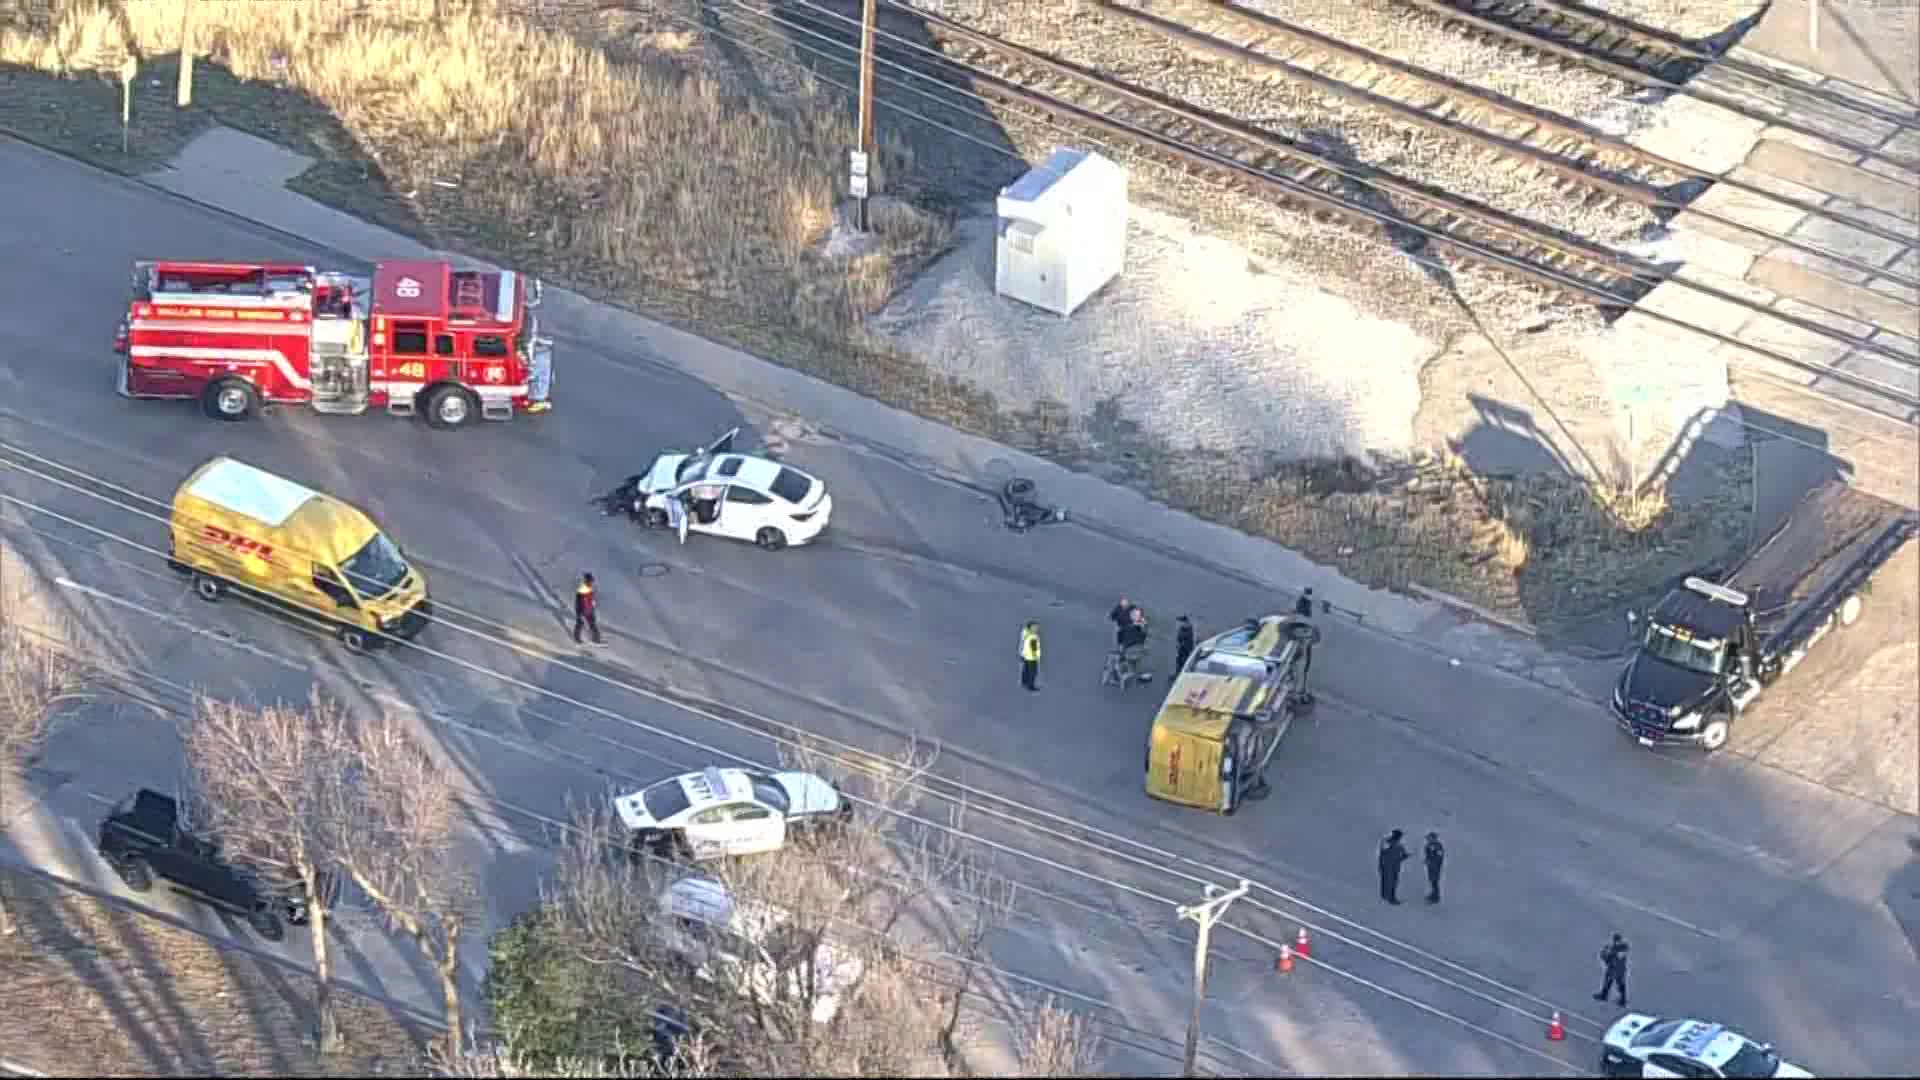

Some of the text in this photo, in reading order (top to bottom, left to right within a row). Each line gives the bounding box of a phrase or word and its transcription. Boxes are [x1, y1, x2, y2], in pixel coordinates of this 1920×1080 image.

[396, 274, 420, 297] 48
[400, 361, 425, 378] 48
[202, 523, 273, 562] DHL
